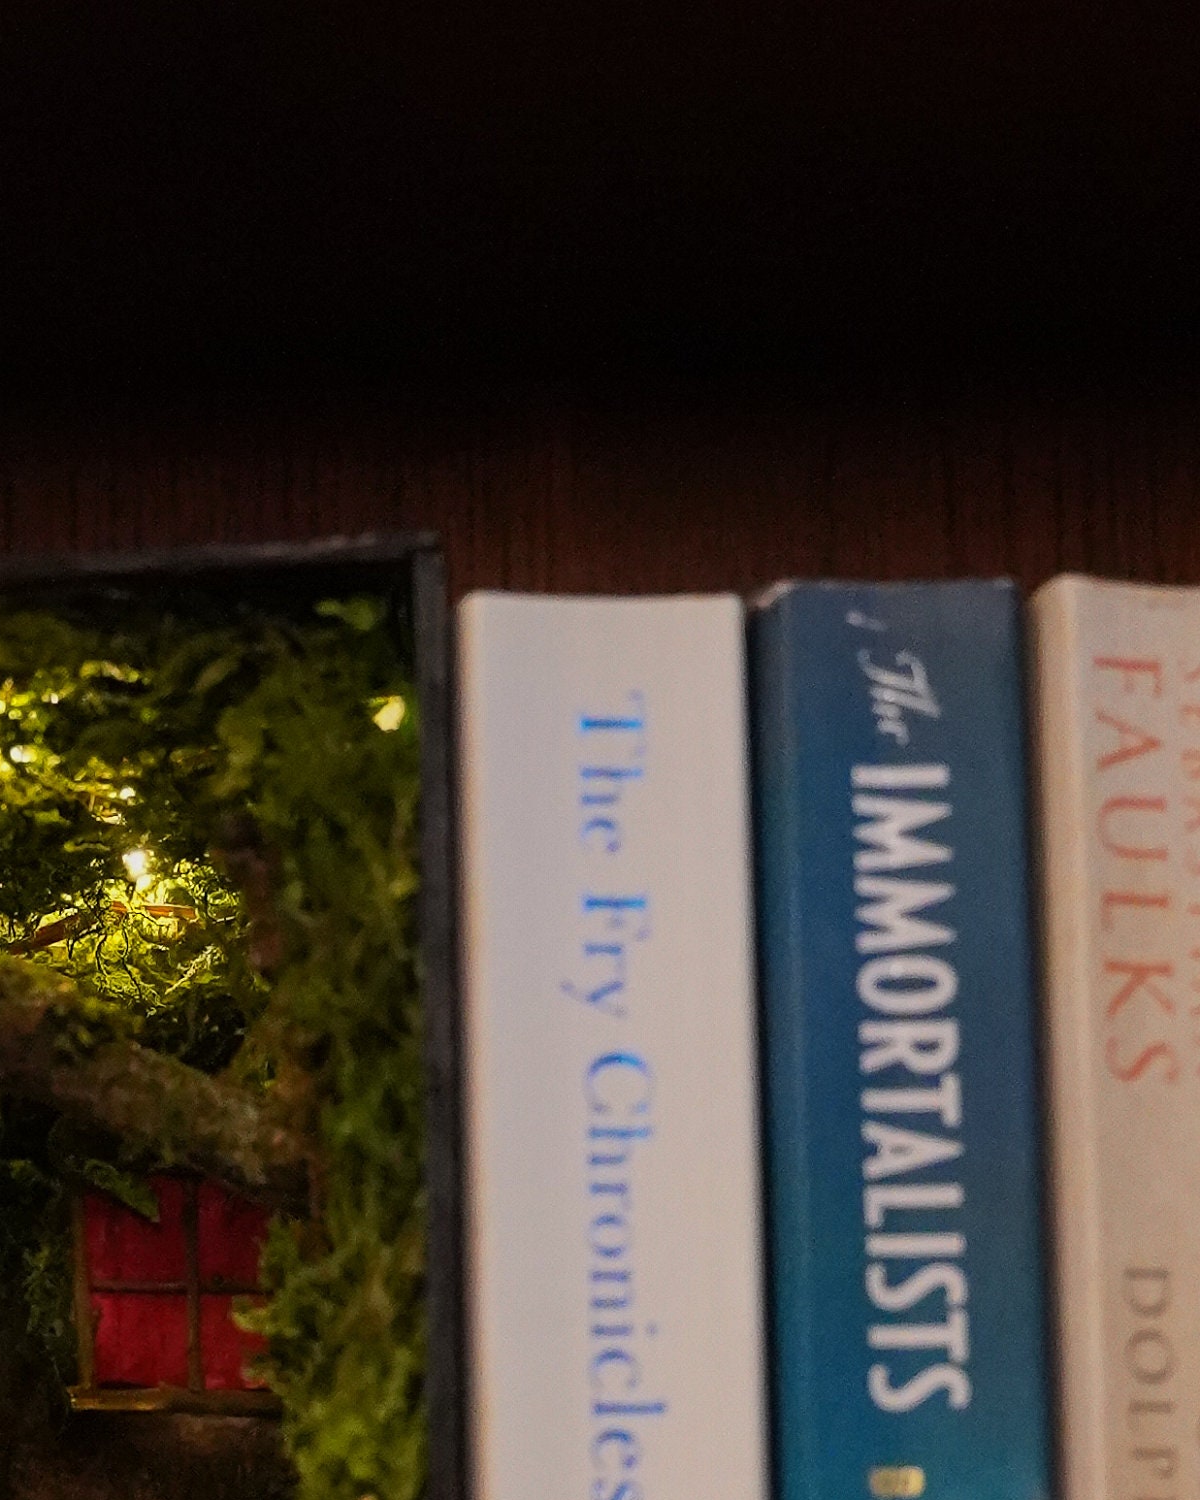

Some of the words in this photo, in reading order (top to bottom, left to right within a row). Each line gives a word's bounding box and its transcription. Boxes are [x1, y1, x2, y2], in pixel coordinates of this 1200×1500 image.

[579, 688, 646, 854] The
[855, 648, 941, 747] The
[1093, 655, 1180, 1086] FAULKS
[561, 893, 649, 1020] Fry
[850, 762, 971, 1412] IMMORTALISTS
